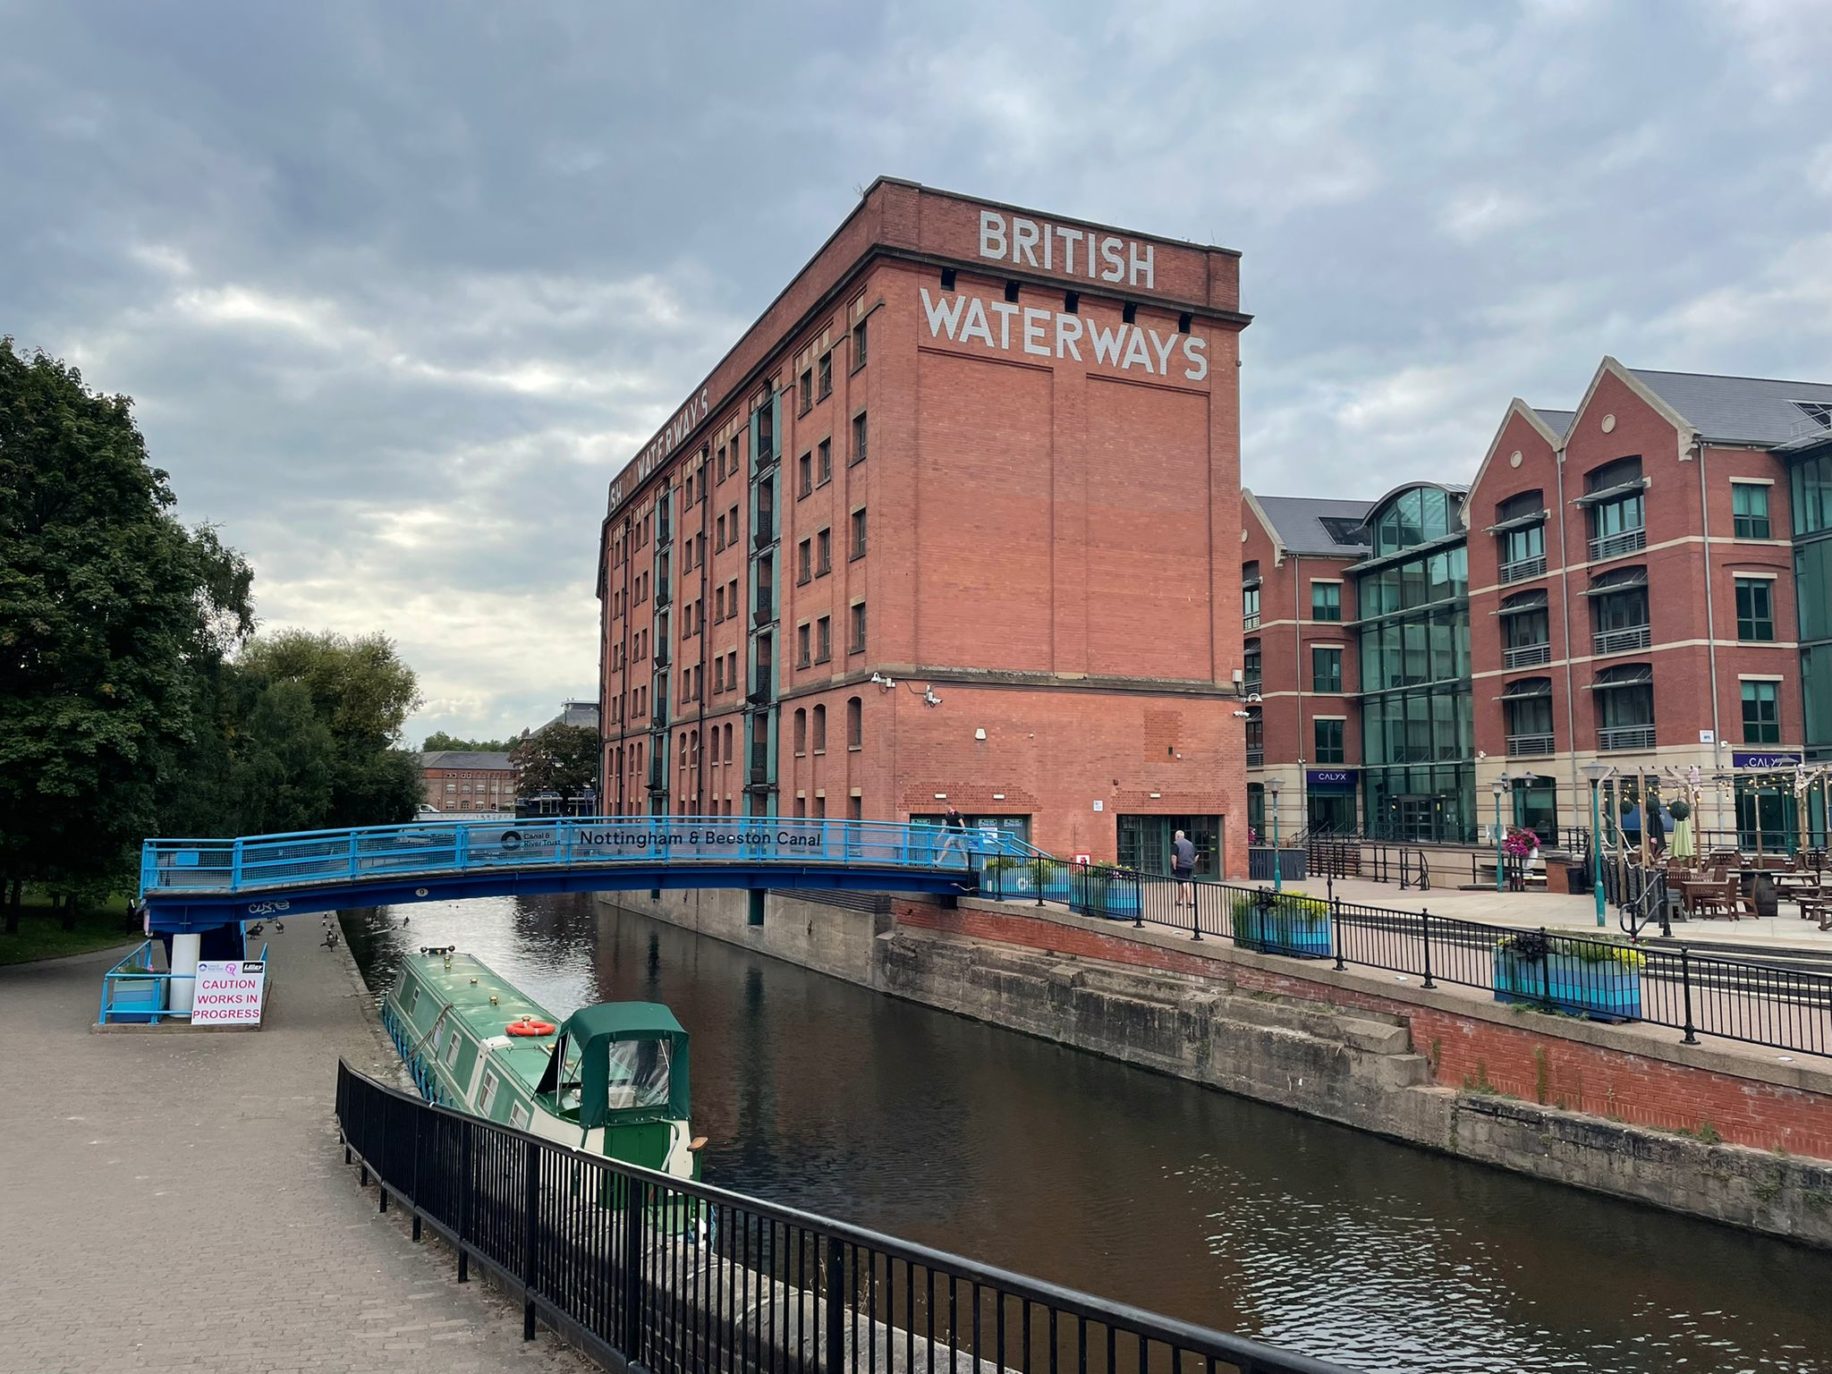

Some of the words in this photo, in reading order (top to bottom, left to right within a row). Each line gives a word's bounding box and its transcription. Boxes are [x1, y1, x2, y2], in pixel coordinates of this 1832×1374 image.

[979, 210, 1154, 288] BRITISH
[920, 288, 1207, 381] WATERWAYS
[637, 388, 708, 483] WATERWAYS
[1318, 773, 1347, 781] CALYX
[580, 830, 683, 849] Nottingham
[688, 831, 699, 844] &
[705, 831, 771, 844] Beeston
[777, 832, 821, 847] Canal
[202, 980, 256, 989] CAUTION
[197, 994, 243, 1004] WORKS
[246, 994, 258, 1003] IN
[193, 1009, 260, 1019] PROGRESS
